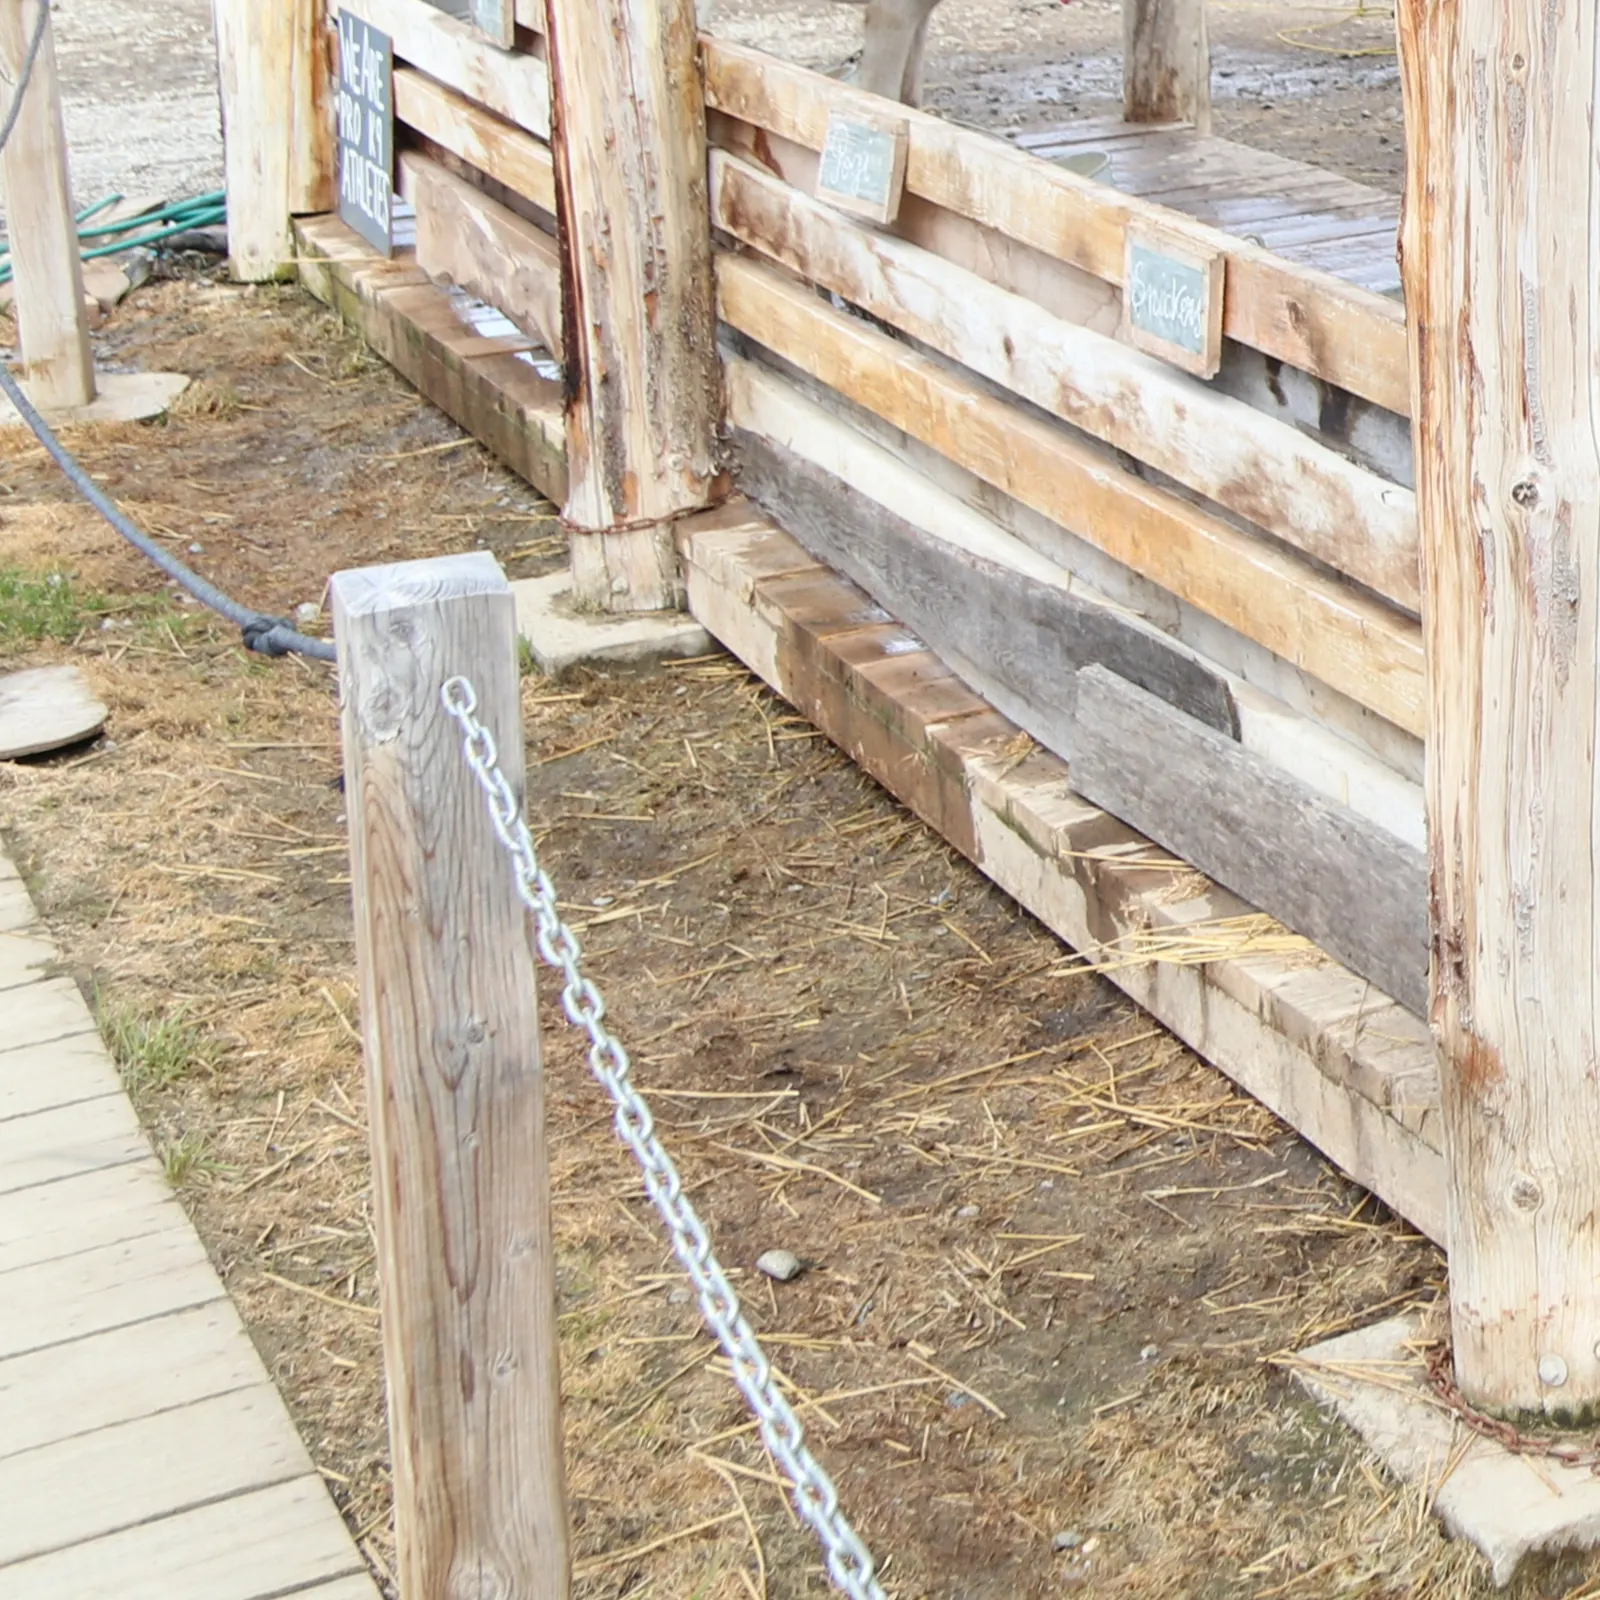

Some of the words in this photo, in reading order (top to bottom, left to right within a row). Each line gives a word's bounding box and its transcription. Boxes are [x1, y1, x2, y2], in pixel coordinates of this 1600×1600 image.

[338, 16, 361, 96] WE
[361, 25, 385, 112] ARE
[340, 90, 361, 146] PRO
[368, 108, 383, 166] K9
[342, 146, 390, 235] ATHLETES
